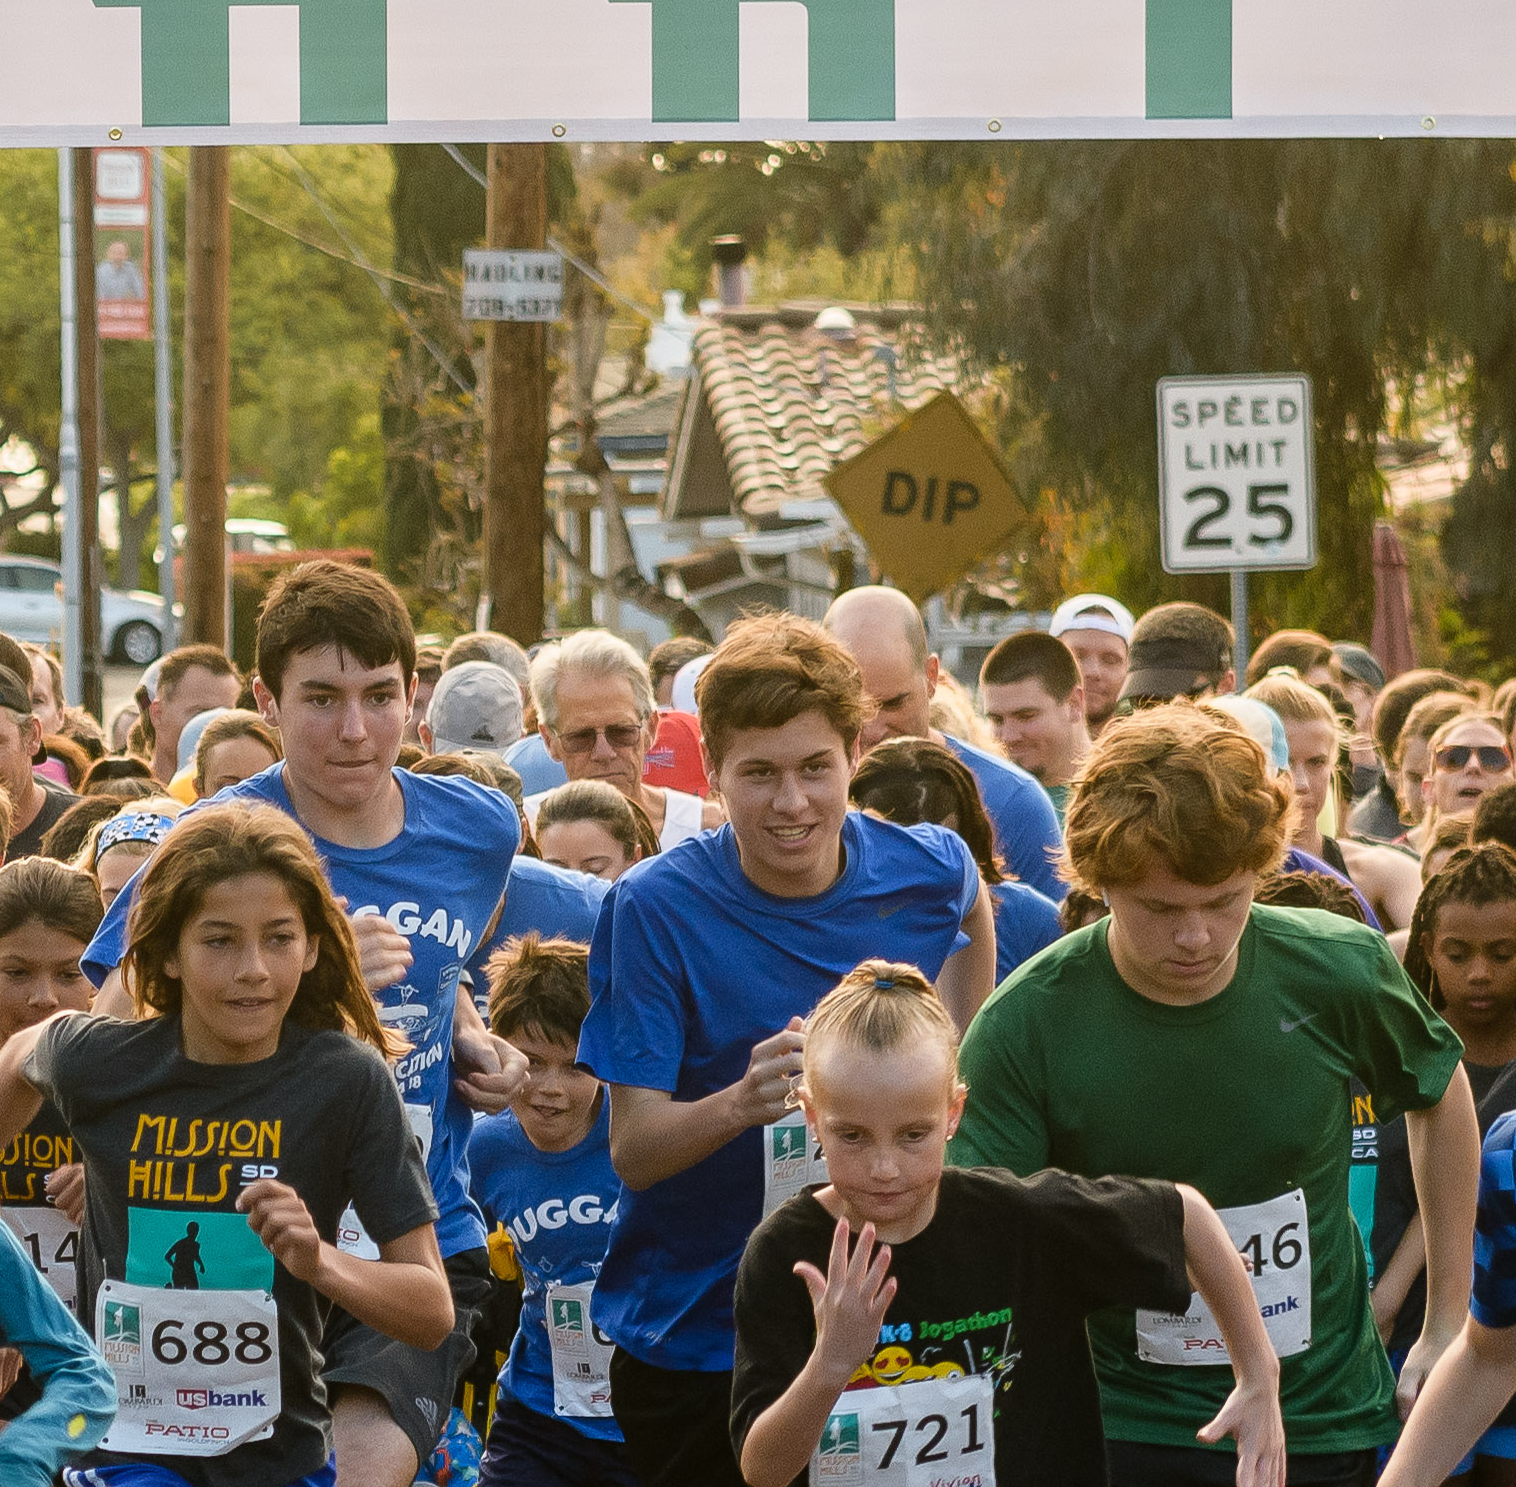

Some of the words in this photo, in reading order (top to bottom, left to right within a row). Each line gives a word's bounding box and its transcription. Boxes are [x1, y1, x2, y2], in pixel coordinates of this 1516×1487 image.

[1171, 394, 1298, 427] SPEED
[1185, 440, 1287, 471] LIMIT
[882, 470, 980, 524] DIP
[1182, 483, 1295, 550] 25
[130, 1113, 282, 1159] MISSION
[127, 1159, 233, 1203] HILLS
[241, 1164, 278, 1179] SD
[152, 1320, 273, 1365] 688
[145, 1424, 230, 1439] PATIO
[872, 1404, 984, 1469] 721
